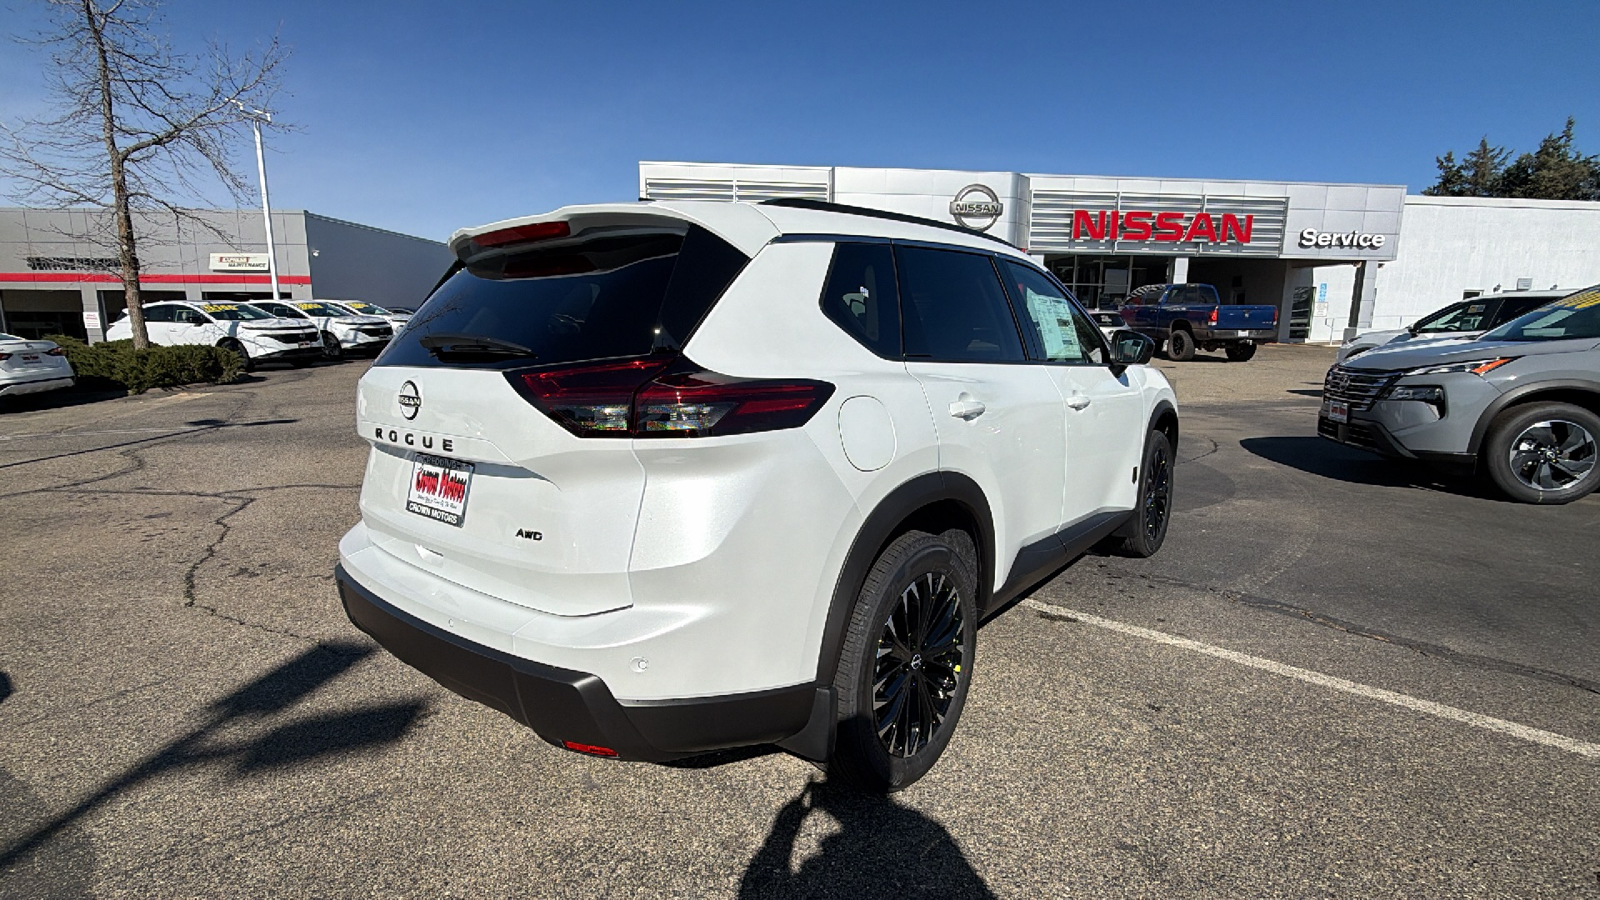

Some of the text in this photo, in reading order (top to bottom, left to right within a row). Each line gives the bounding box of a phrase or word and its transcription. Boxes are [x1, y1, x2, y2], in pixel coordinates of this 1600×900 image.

[955, 203, 999, 213] NISSAN
[1072, 209, 1254, 244] NISSAN
[1300, 228, 1386, 248] Service
[375, 427, 454, 452] ROGUE
[408, 503, 458, 524] CROWN MOTORS
[515, 528, 543, 541] AWD
